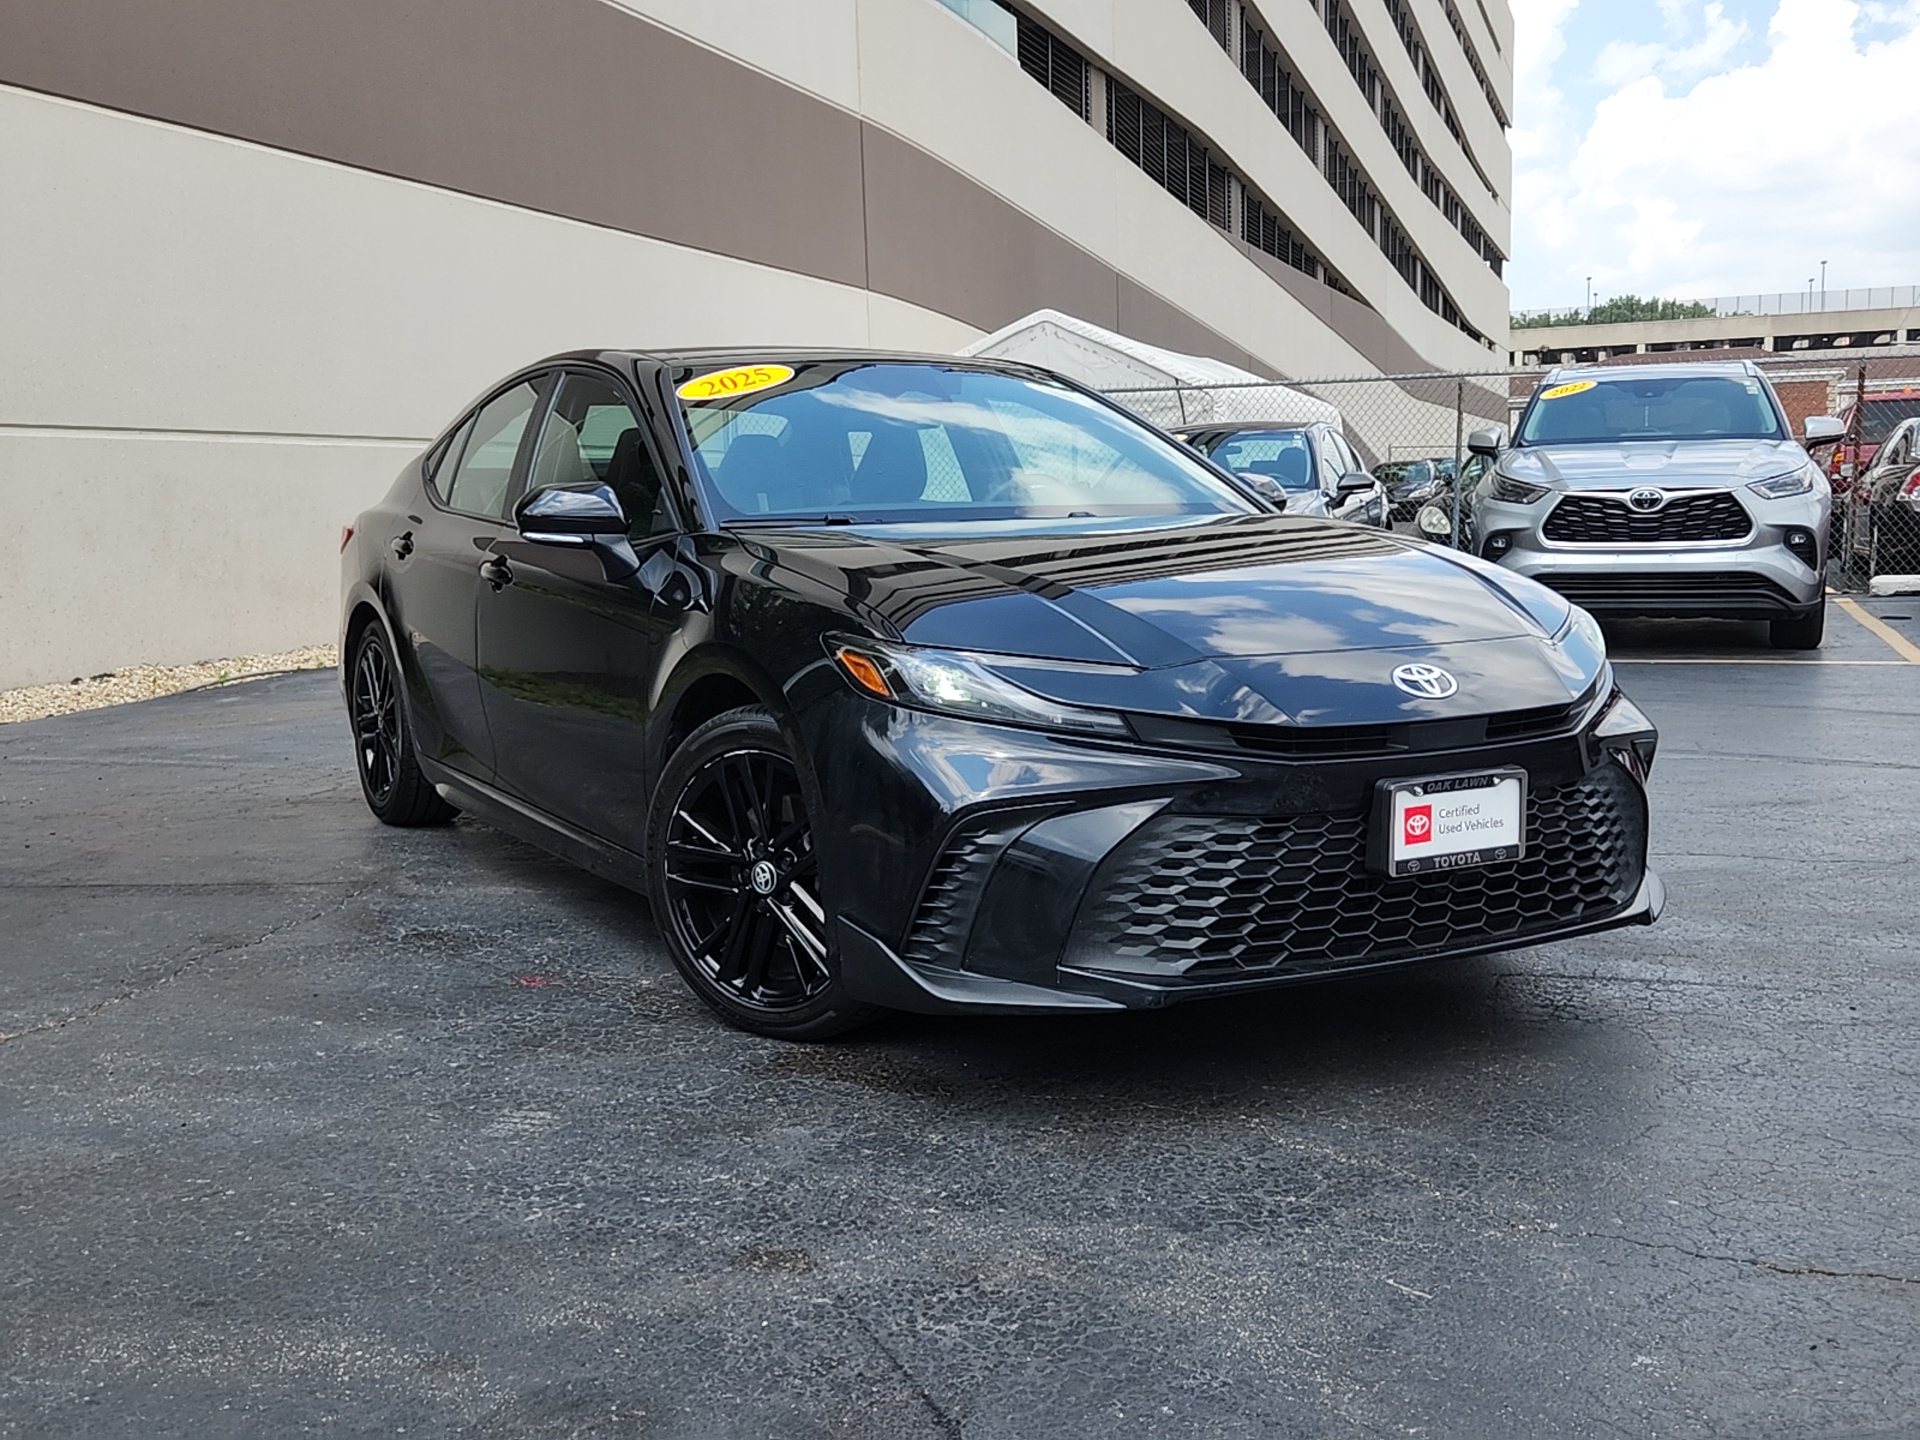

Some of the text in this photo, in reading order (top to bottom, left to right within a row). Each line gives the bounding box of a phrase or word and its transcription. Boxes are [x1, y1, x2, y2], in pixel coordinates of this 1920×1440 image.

[700, 368, 771, 396] 2025
[1427, 776, 1489, 792] OAK LAWN
[1438, 804, 1480, 819] Certified
[1438, 817, 1504, 834] Used Vehicles
[1433, 851, 1481, 868] TOYOTA
